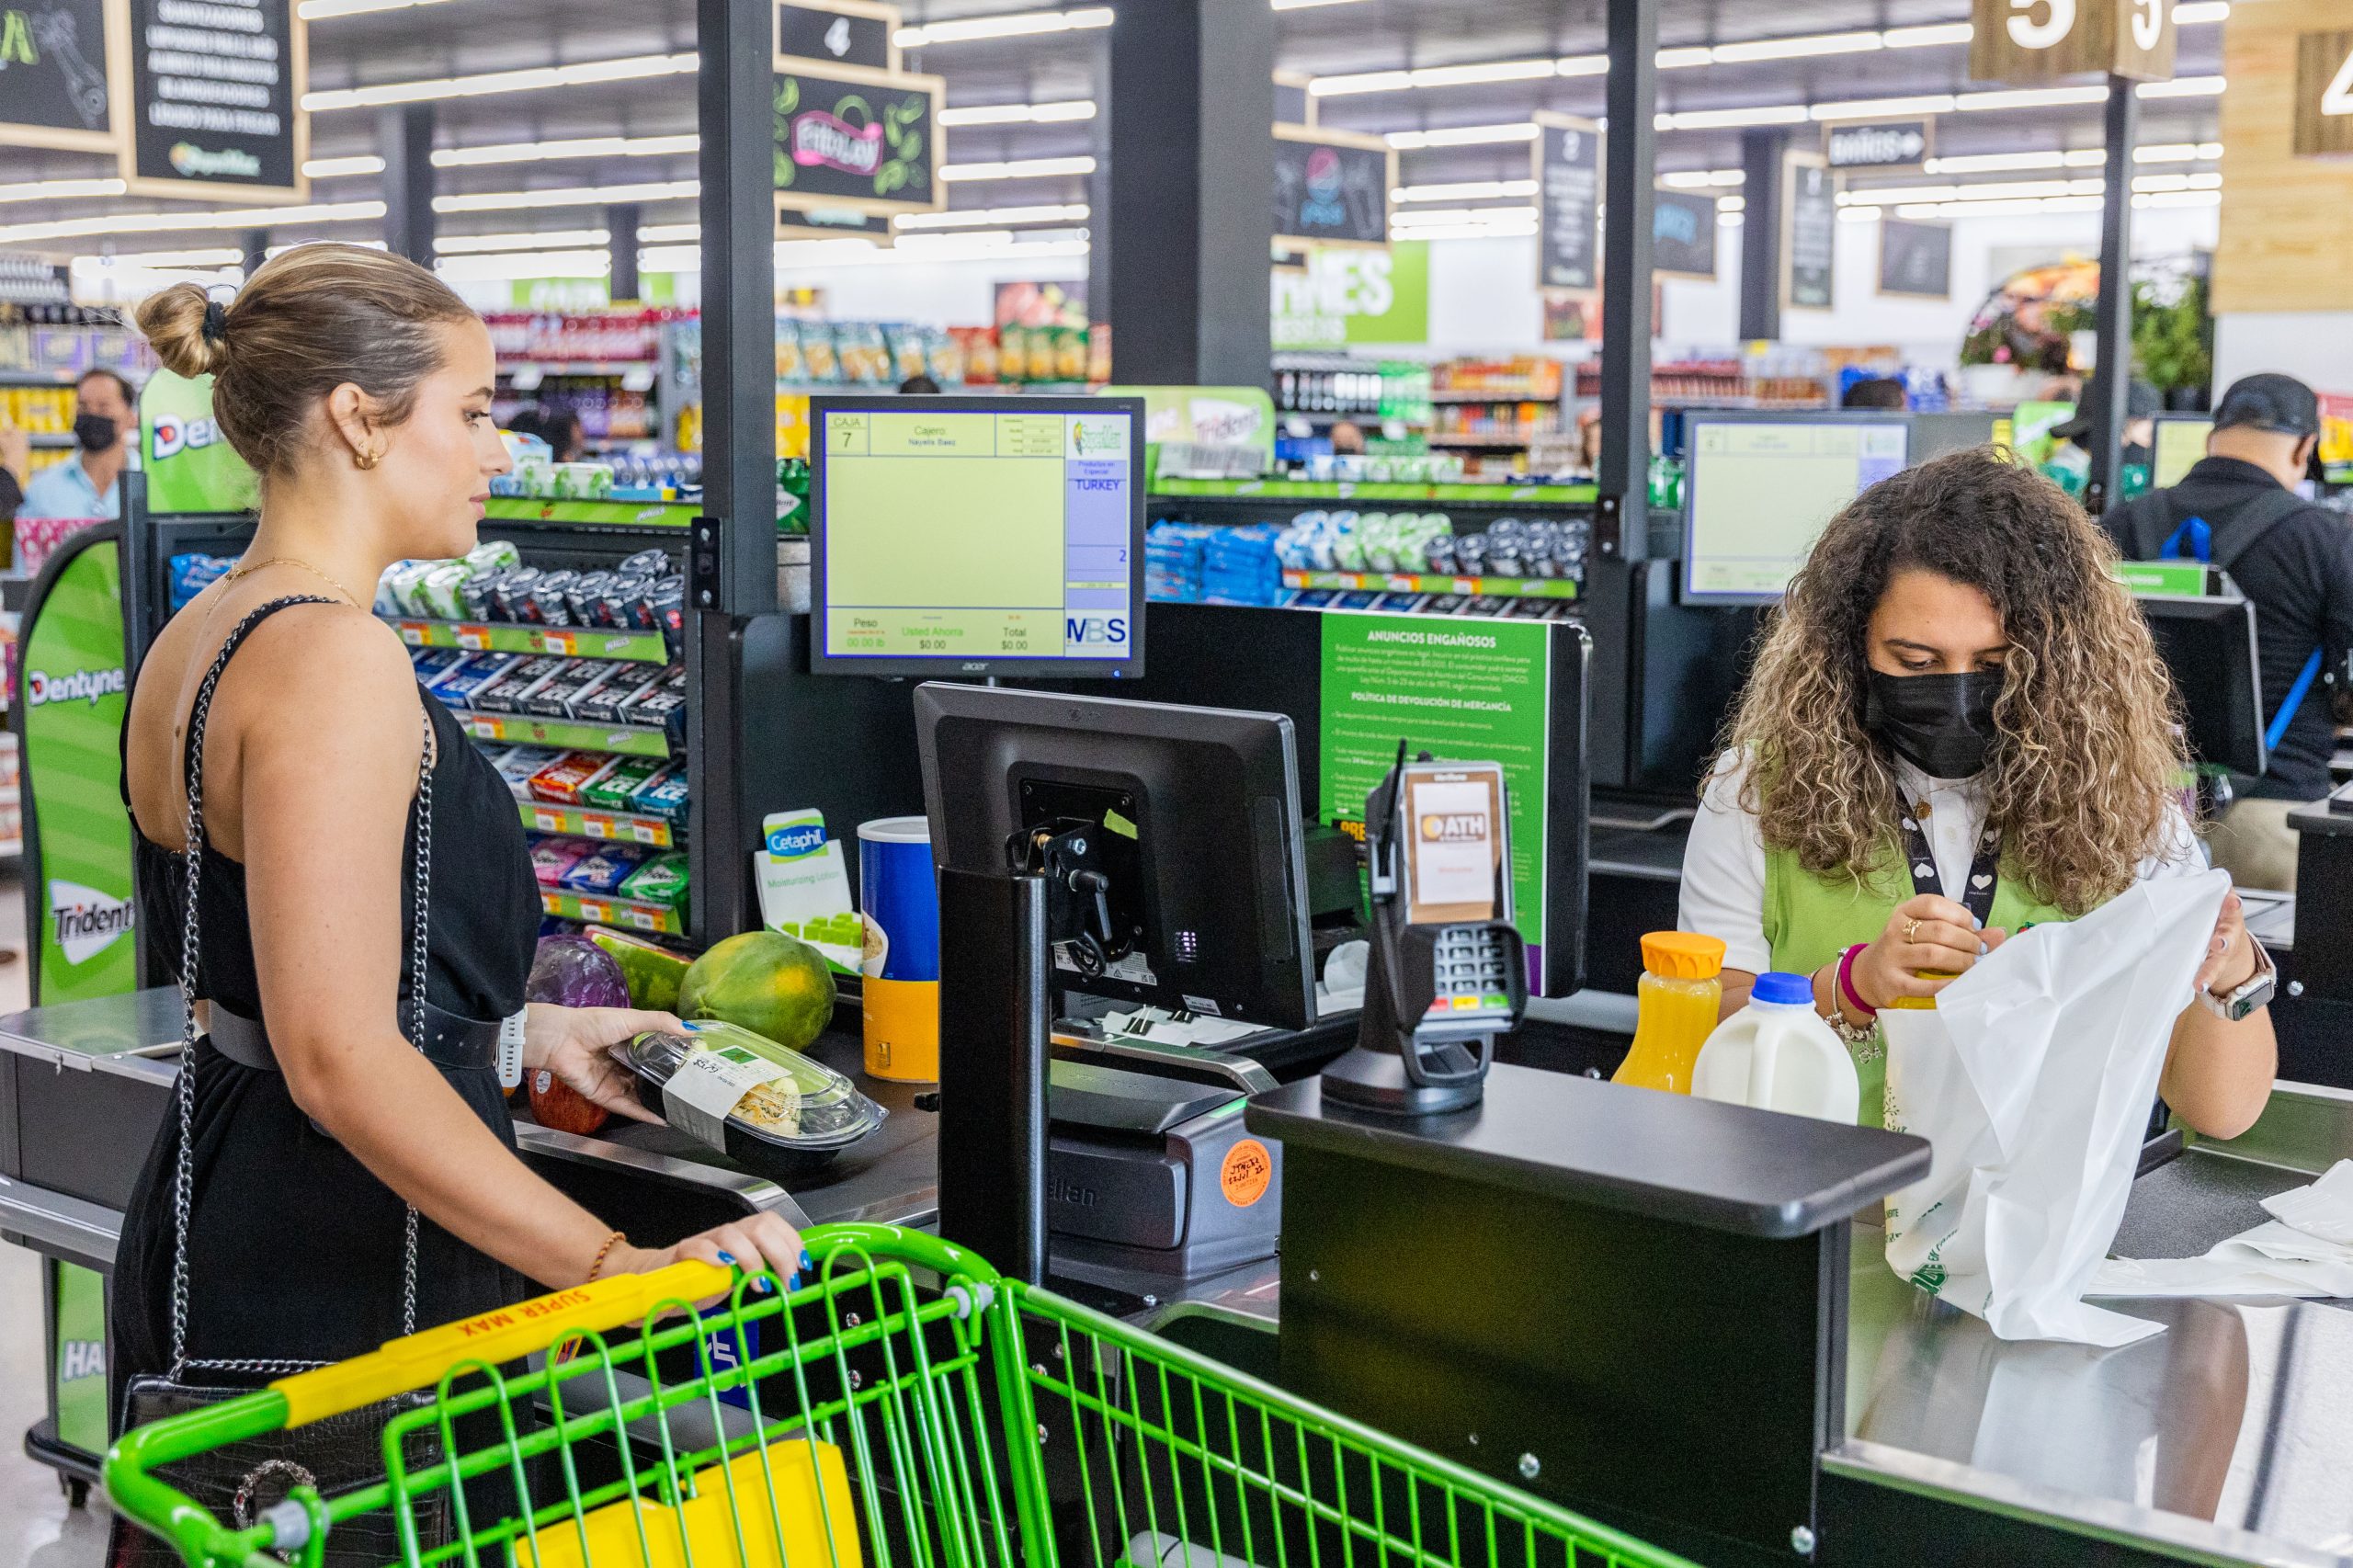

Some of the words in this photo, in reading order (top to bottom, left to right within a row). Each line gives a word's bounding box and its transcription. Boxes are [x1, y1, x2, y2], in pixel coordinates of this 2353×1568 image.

[834, 418, 860, 427] CAJA
[842, 432, 852, 448] 7
[1075, 479, 1120, 491] TURKEY
[1120, 550, 1127, 562] 2
[854, 618, 878, 629] Peso
[902, 627, 929, 637] Usted
[932, 627, 964, 637] Ahorra
[1003, 627, 1028, 637] Total
[1067, 618, 1126, 643] MBS
[1368, 631, 1425, 644] ANUNCIOS
[1427, 632, 1496, 649] ENGAÑOSOS
[962, 662, 988, 672] acer
[28, 668, 126, 705] Dentyne
[1351, 690, 1384, 703] POLÍTICA
[1386, 693, 1397, 704] DE
[1398, 694, 1449, 708] DEVOLUCIÓN
[1451, 697, 1461, 708] DE
[1463, 698, 1512, 711] MERCANCÍA
[1444, 815, 1485, 835] ATH
[770, 828, 824, 852] Cetaphil
[767, 874, 815, 889] Moisturizing
[52, 895, 135, 945] Trident
[524, 1290, 591, 1320] SUPER
[456, 1315, 515, 1338] MAX
[62, 1339, 106, 1382] HA
